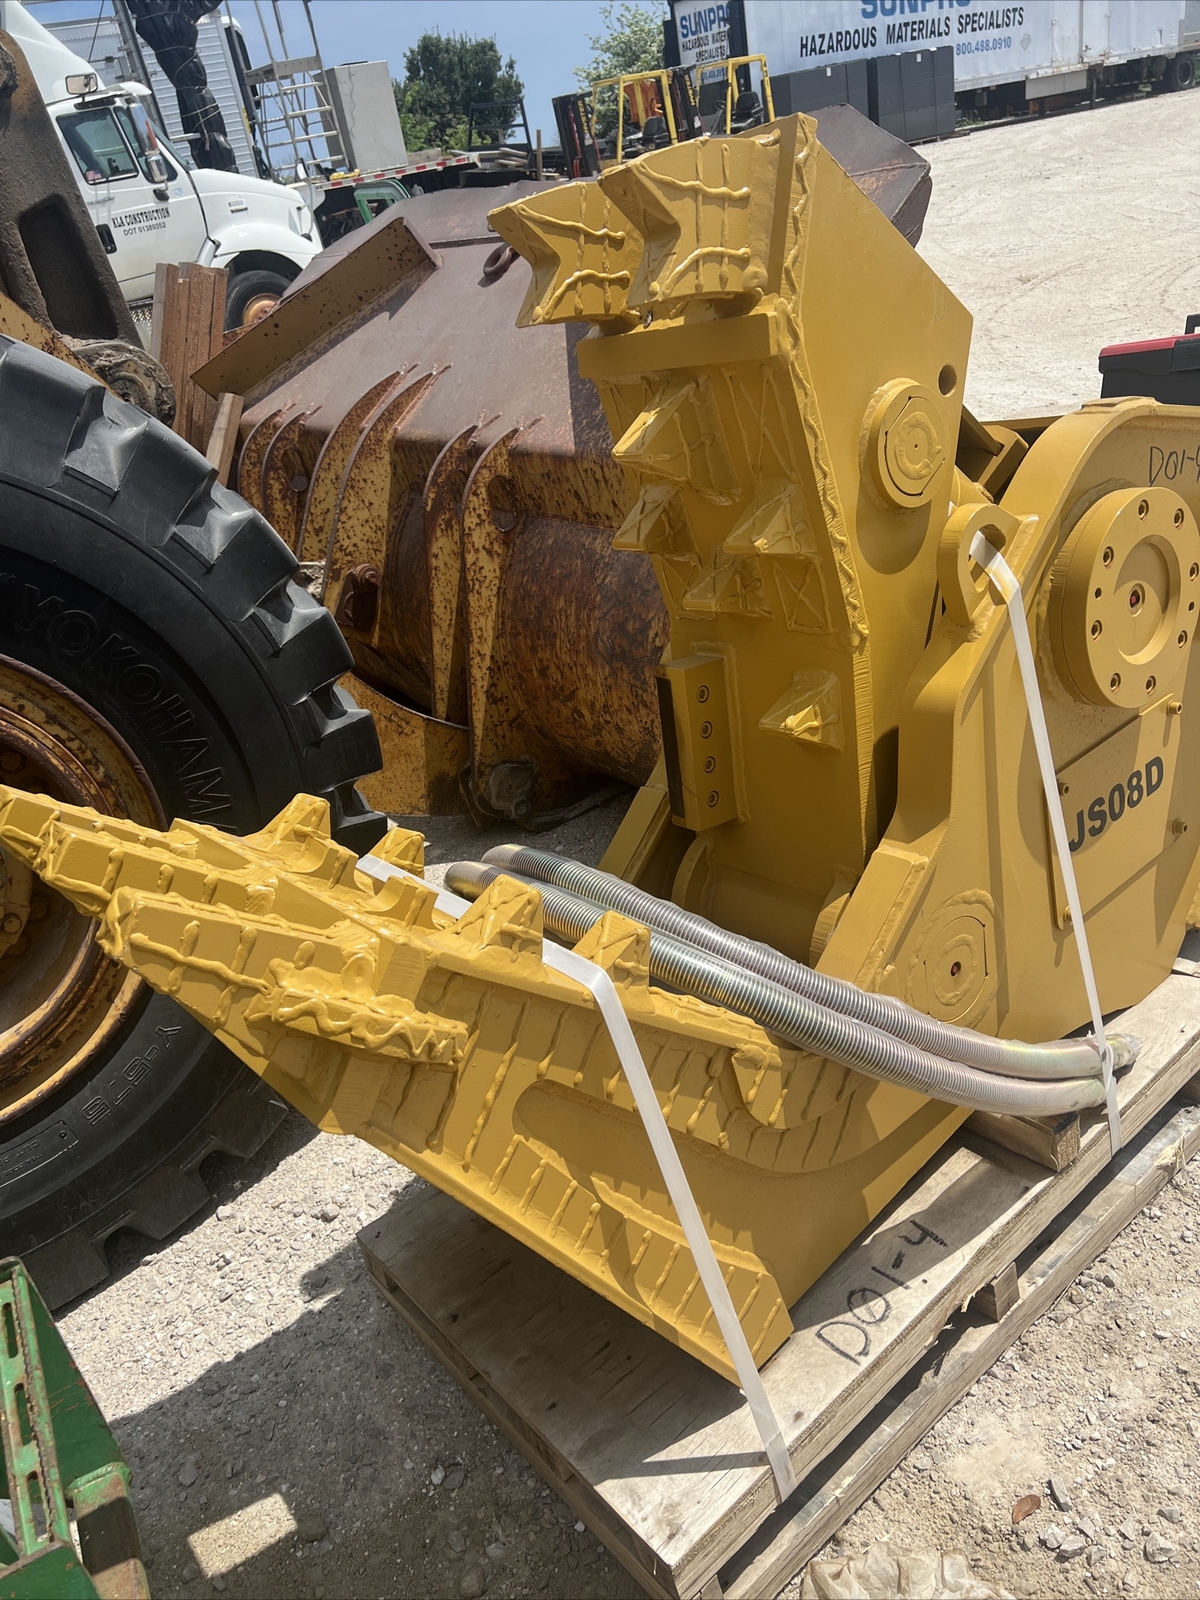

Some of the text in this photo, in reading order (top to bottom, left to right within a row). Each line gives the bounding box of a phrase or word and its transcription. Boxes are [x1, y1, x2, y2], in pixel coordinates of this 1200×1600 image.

[680, 5, 730, 38] SUNPR
[800, 26, 877, 58] HAZARDOUS
[886, 16, 951, 45] MATERIALS
[957, 6, 1025, 35] SPECIALISTS
[682, 35, 709, 52] HAZARDOUS
[955, 36, 1012, 56] 800.488.0910
[126, 207, 171, 225] CONSTRUCTION
[123, 227, 137, 236] DOT
[1068, 756, 1164, 853] JS08D
